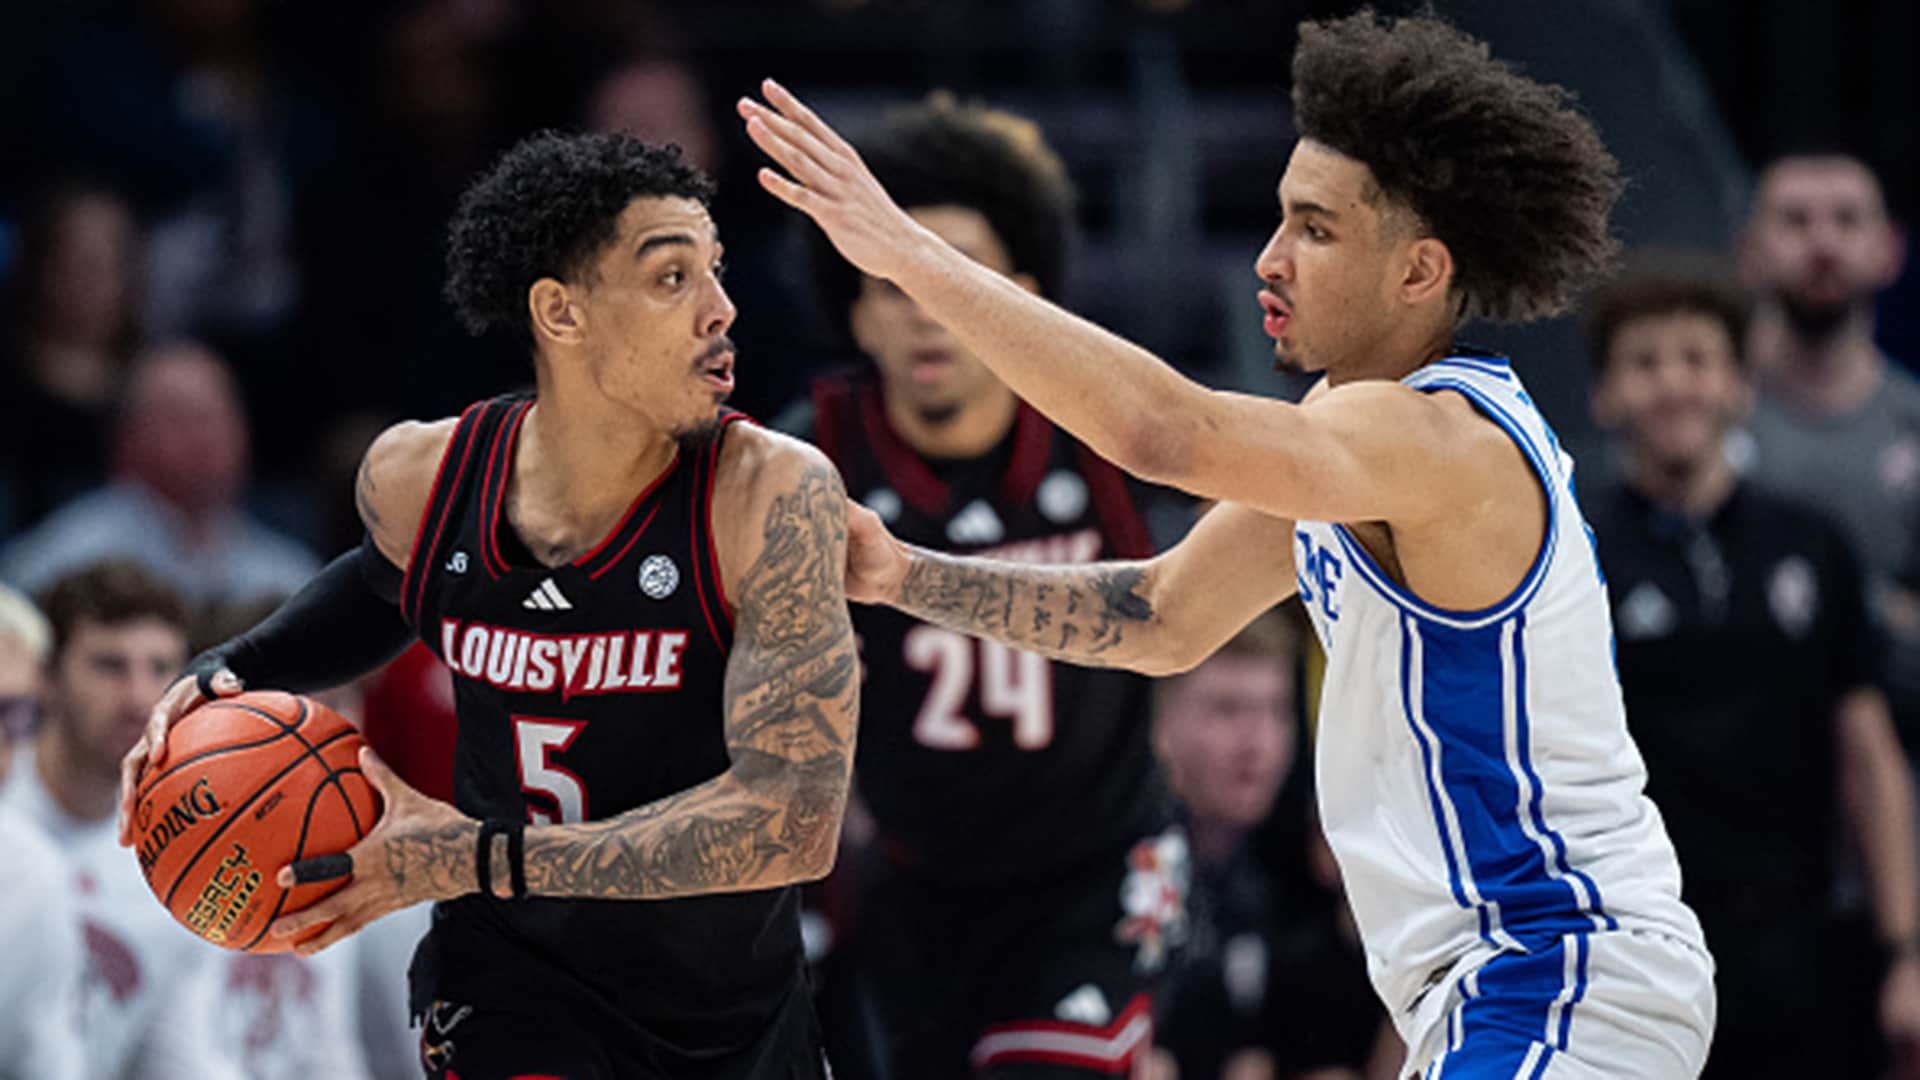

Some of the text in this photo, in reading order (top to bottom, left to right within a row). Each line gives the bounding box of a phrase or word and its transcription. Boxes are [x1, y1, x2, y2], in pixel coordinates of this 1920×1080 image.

[440, 617, 690, 703] LOUISVILLE
[904, 625, 1054, 750] 24
[511, 714, 588, 826] 5
